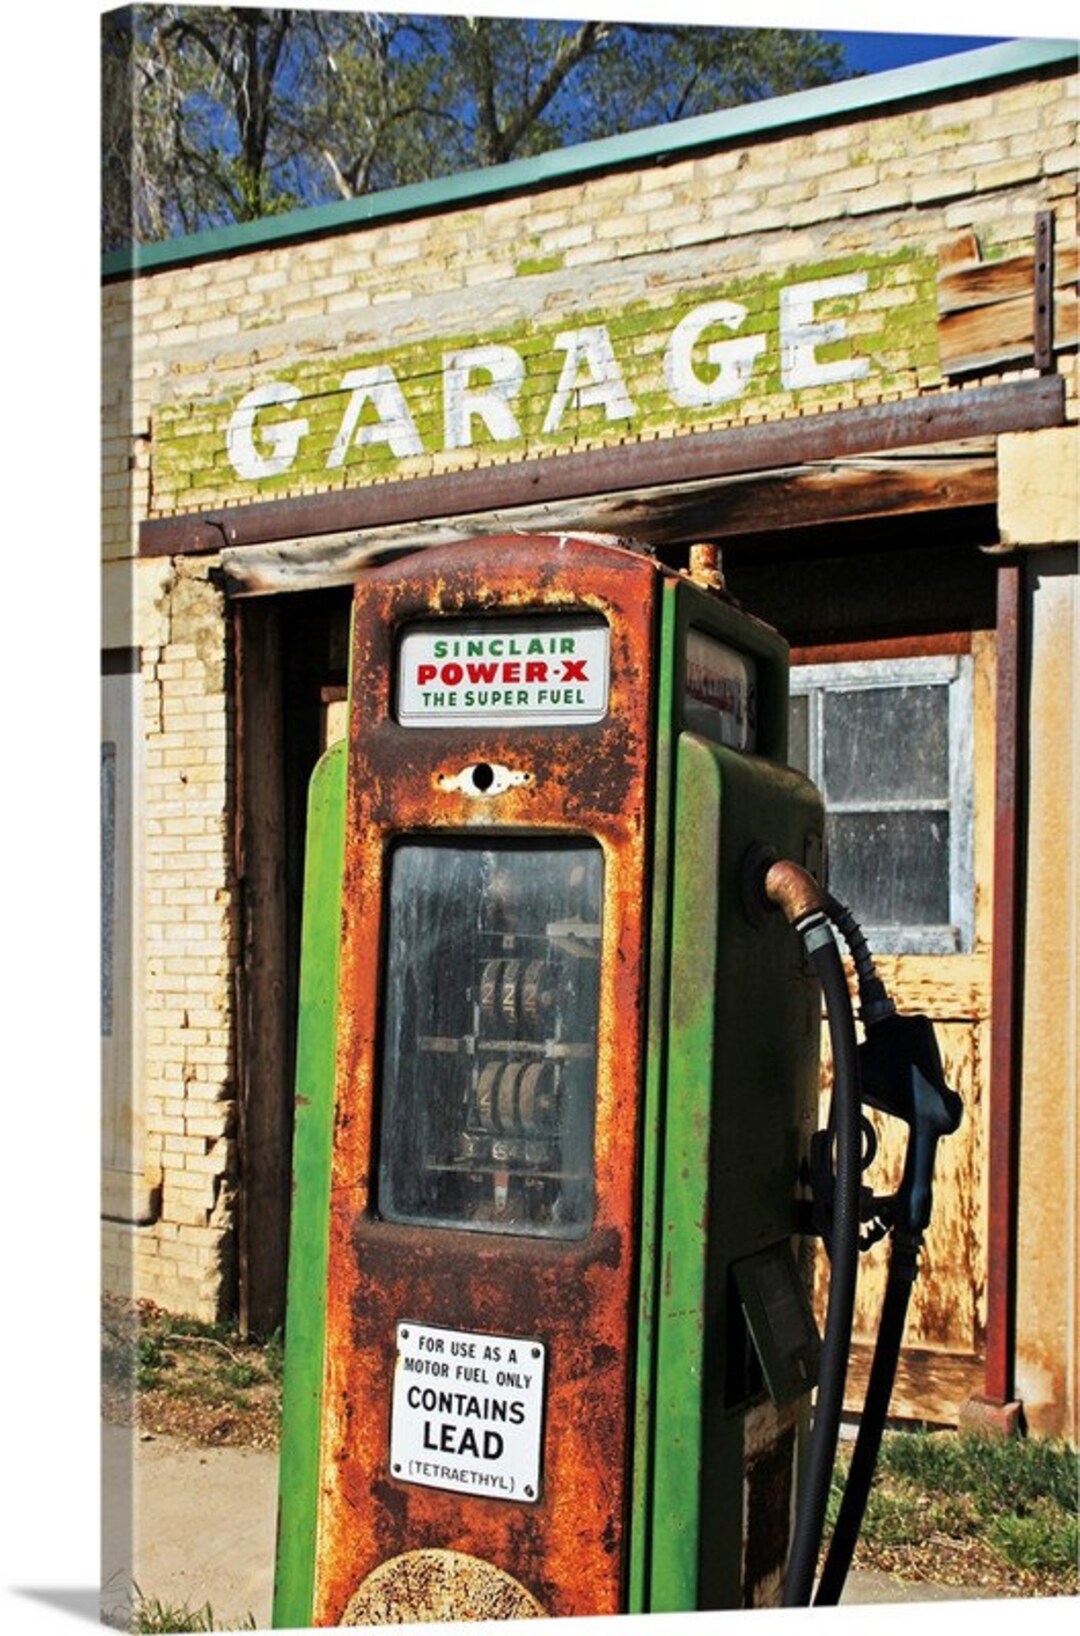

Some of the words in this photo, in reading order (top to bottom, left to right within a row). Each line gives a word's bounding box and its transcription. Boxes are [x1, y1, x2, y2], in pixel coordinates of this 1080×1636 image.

[225, 273, 869, 479] GARAGE
[434, 637, 576, 658] SINCLAIR
[422, 692, 457, 707] THE
[464, 690, 529, 707] SUPER
[537, 689, 585, 705] FUEL
[418, 1336, 445, 1354] FOR
[451, 1341, 476, 1359] USE
[483, 1346, 501, 1362] AS
[508, 1349, 518, 1364] A
[404, 1357, 449, 1377] MOTOR
[456, 1366, 489, 1384] FUEL
[496, 1372, 533, 1389] ONLY
[407, 1386, 526, 1425] CONTAINS
[423, 1421, 504, 1460] LEAD
[408, 1460, 516, 1493] (TETRAETHYL)
